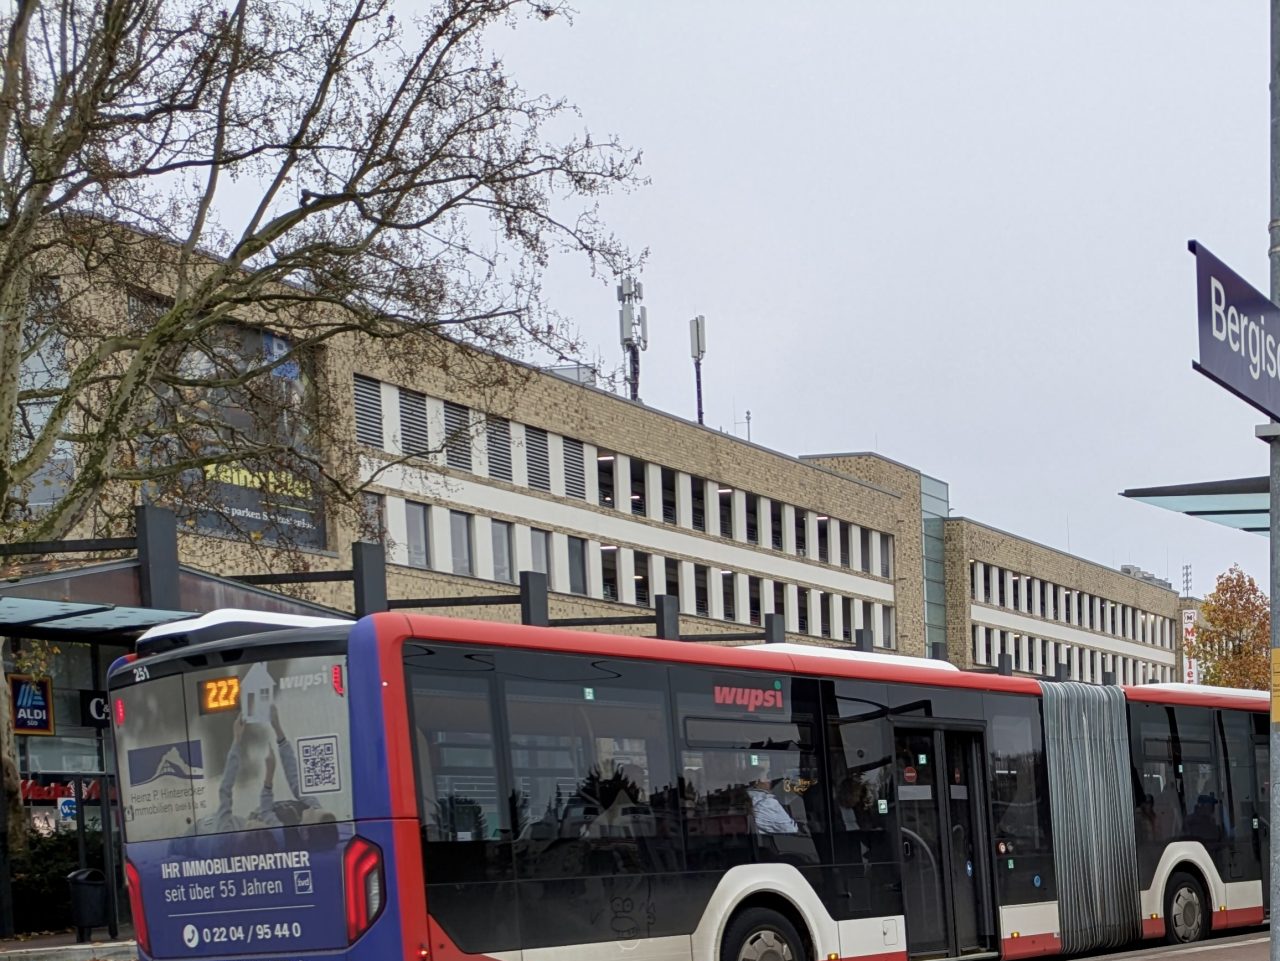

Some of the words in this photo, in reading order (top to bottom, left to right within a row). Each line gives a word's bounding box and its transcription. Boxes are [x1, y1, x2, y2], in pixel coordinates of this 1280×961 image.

[133, 666, 150, 682] 251
[279, 665, 328, 690] wupsi
[206, 678, 239, 709] 227
[714, 680, 783, 712] wupsi
[17, 709, 46, 720] ALDI
[162, 863, 180, 879] IHR
[182, 851, 310, 877] IMMOBILIENPARTNER
[165, 887, 186, 902] seit
[189, 883, 214, 900] über
[220, 880, 236, 897] 55
[241, 878, 283, 896] Jahren
[203, 929, 211, 942] 0
[213, 927, 228, 941] 22
[229, 926, 245, 940] 04
[247, 925, 254, 943] /
[256, 924, 272, 939] 95
[274, 923, 290, 938] 44
[292, 922, 301, 936] 0
